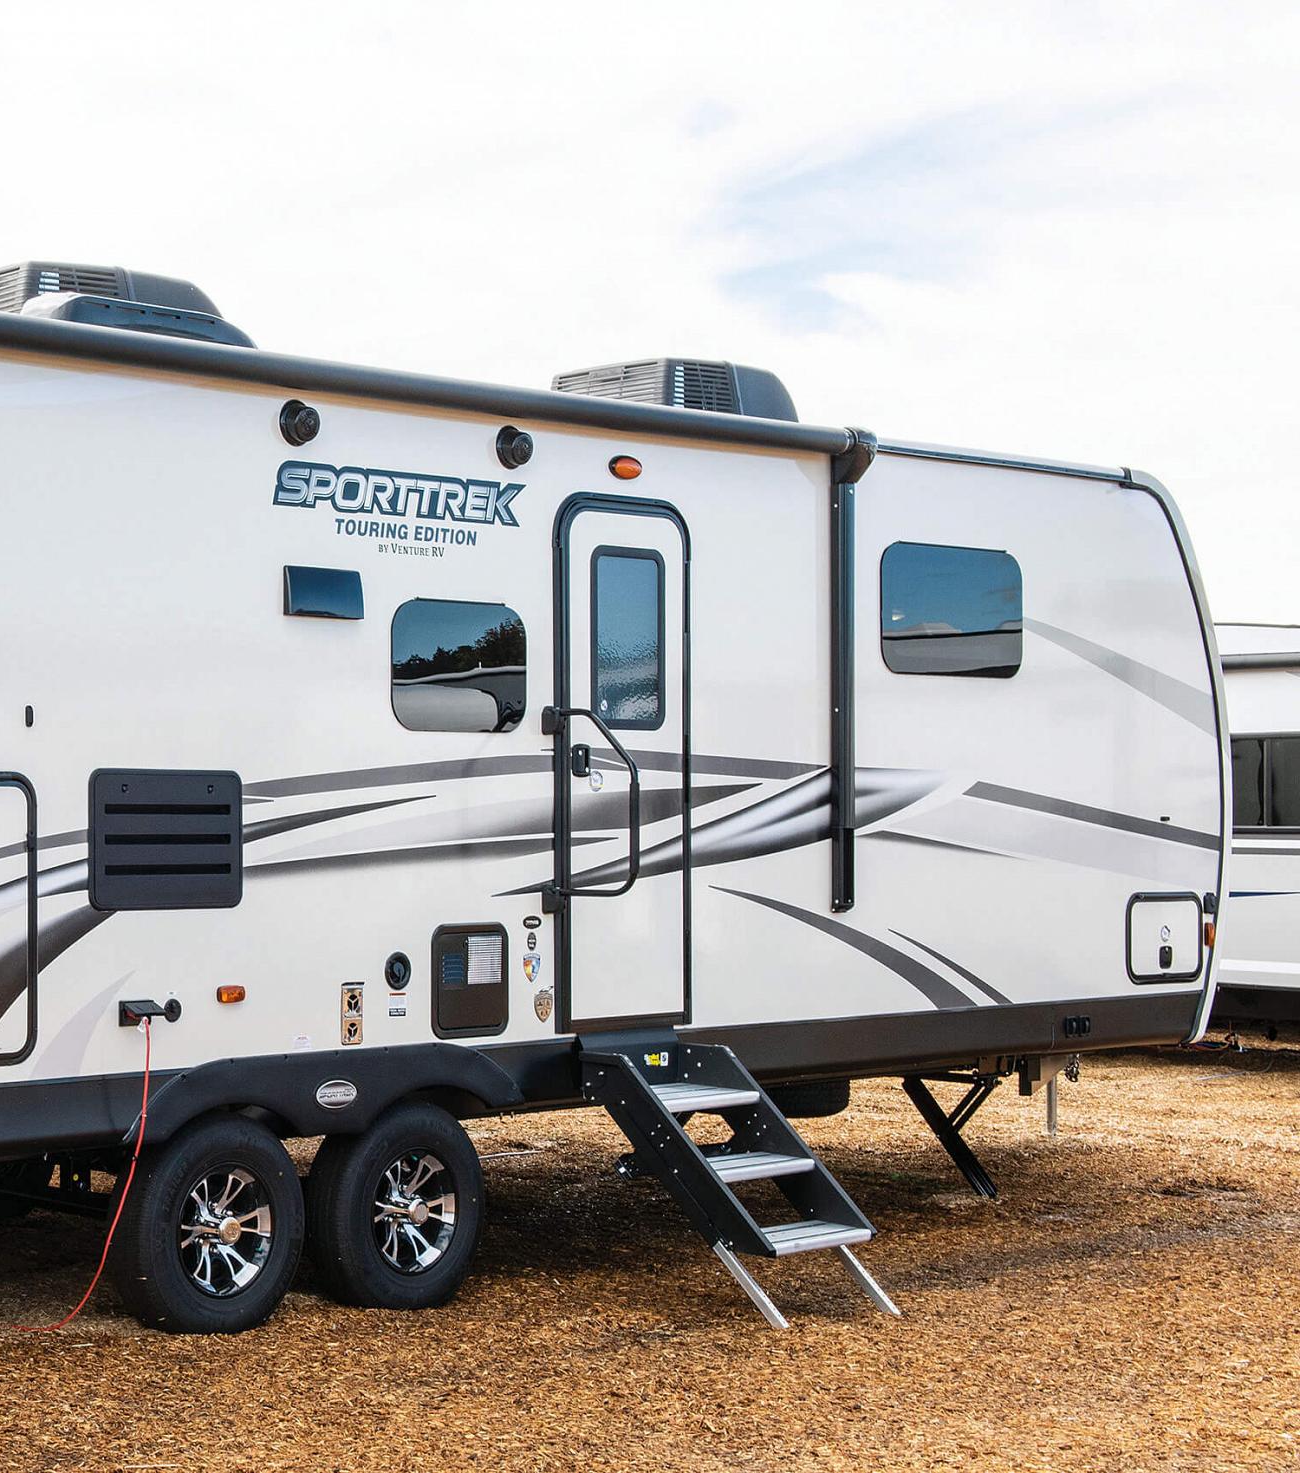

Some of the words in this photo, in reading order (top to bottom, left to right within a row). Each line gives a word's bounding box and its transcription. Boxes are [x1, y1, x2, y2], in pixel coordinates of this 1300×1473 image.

[273, 460, 527, 527] SPORTTREK
[335, 519, 408, 541] TOURING
[414, 526, 478, 546] EDITION
[431, 547, 445, 558] RV
